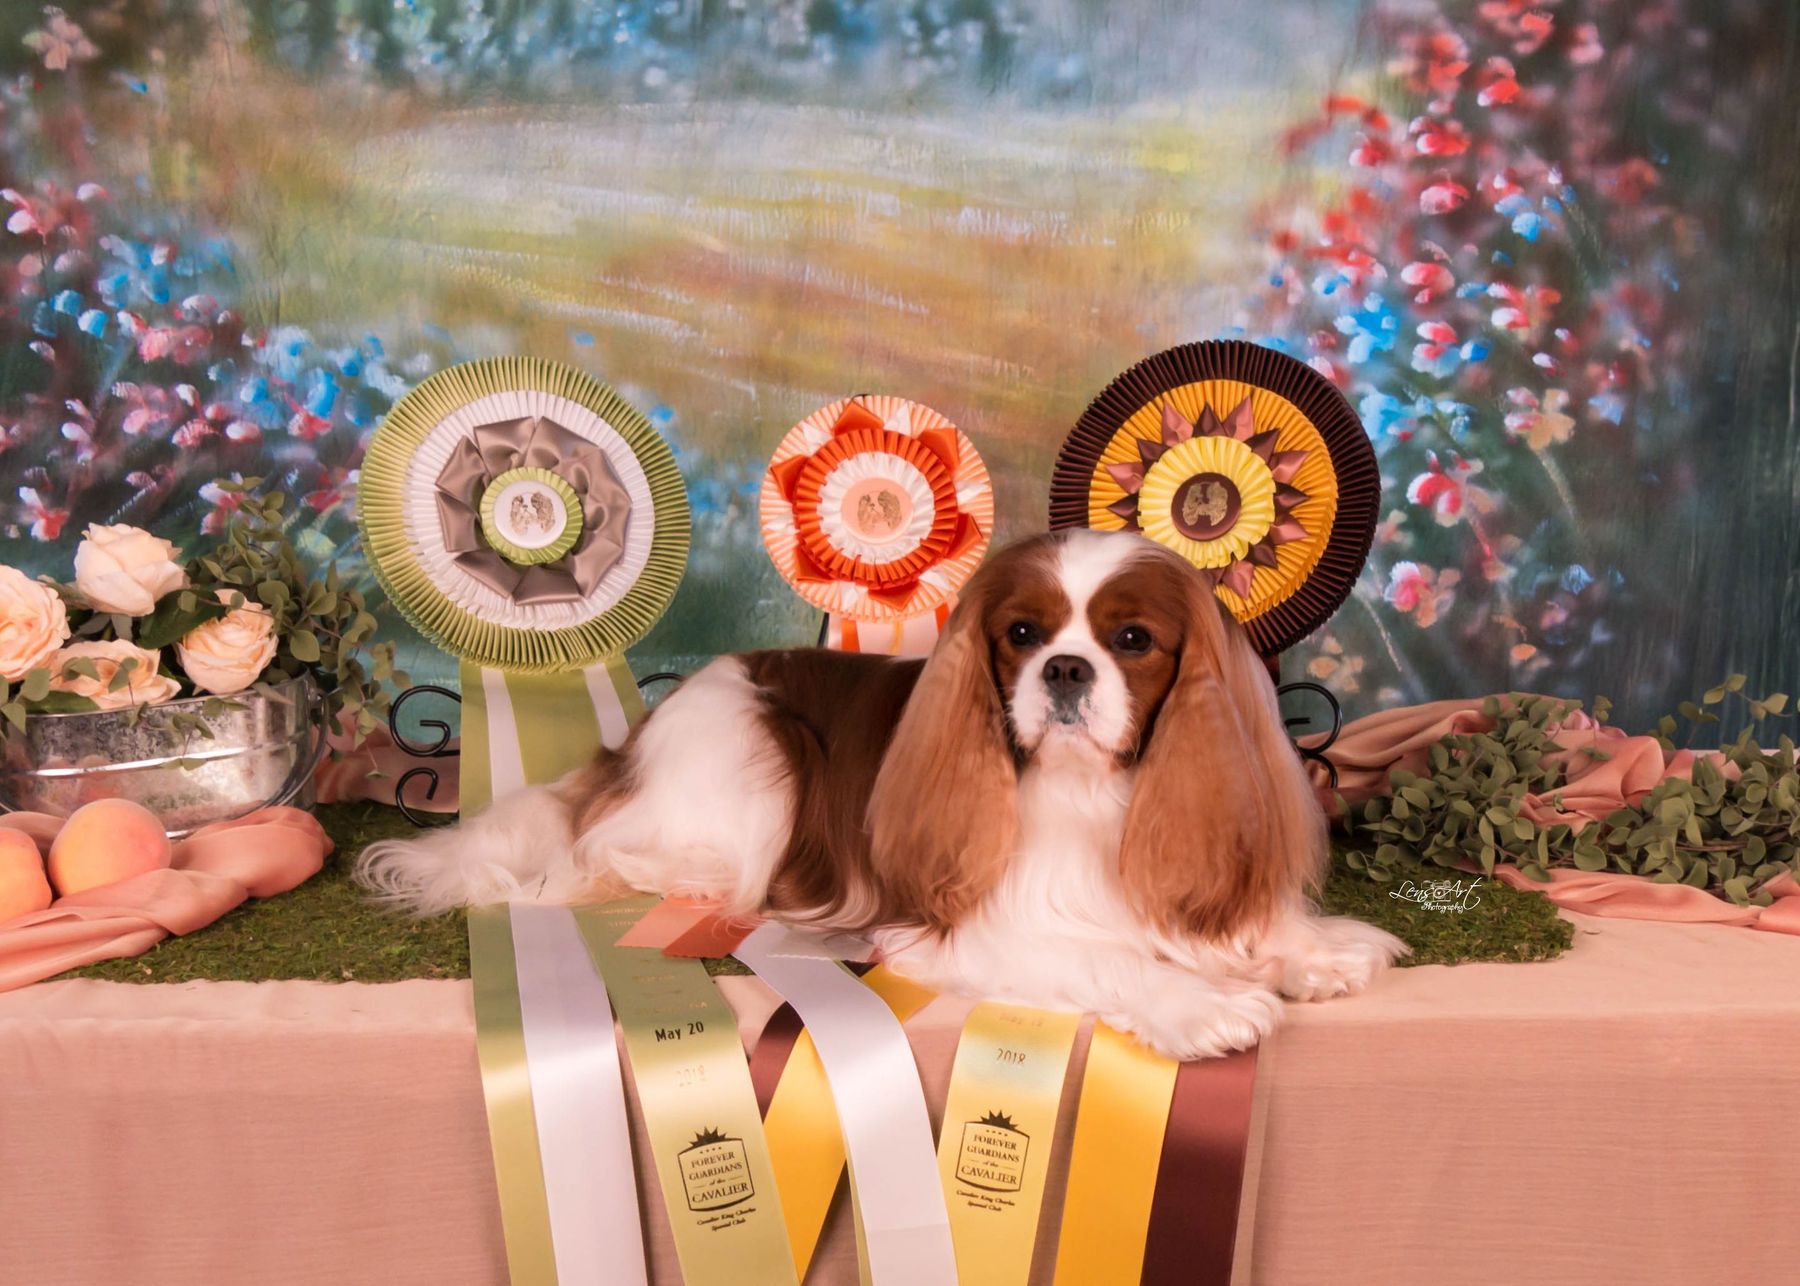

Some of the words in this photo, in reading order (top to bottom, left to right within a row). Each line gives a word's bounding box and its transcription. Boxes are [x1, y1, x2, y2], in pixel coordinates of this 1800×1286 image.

[655, 1028, 681, 1042] May
[687, 1021, 705, 1036] 20
[974, 1133, 1017, 1151] FOREVER
[691, 1151, 735, 1168] FOREVER
[966, 1145, 1020, 1163] GUARDIANS
[688, 1162, 743, 1181] GUARDIANS
[961, 1165, 1018, 1185] CAVALIER
[692, 1182, 749, 1203] CAVALIER
